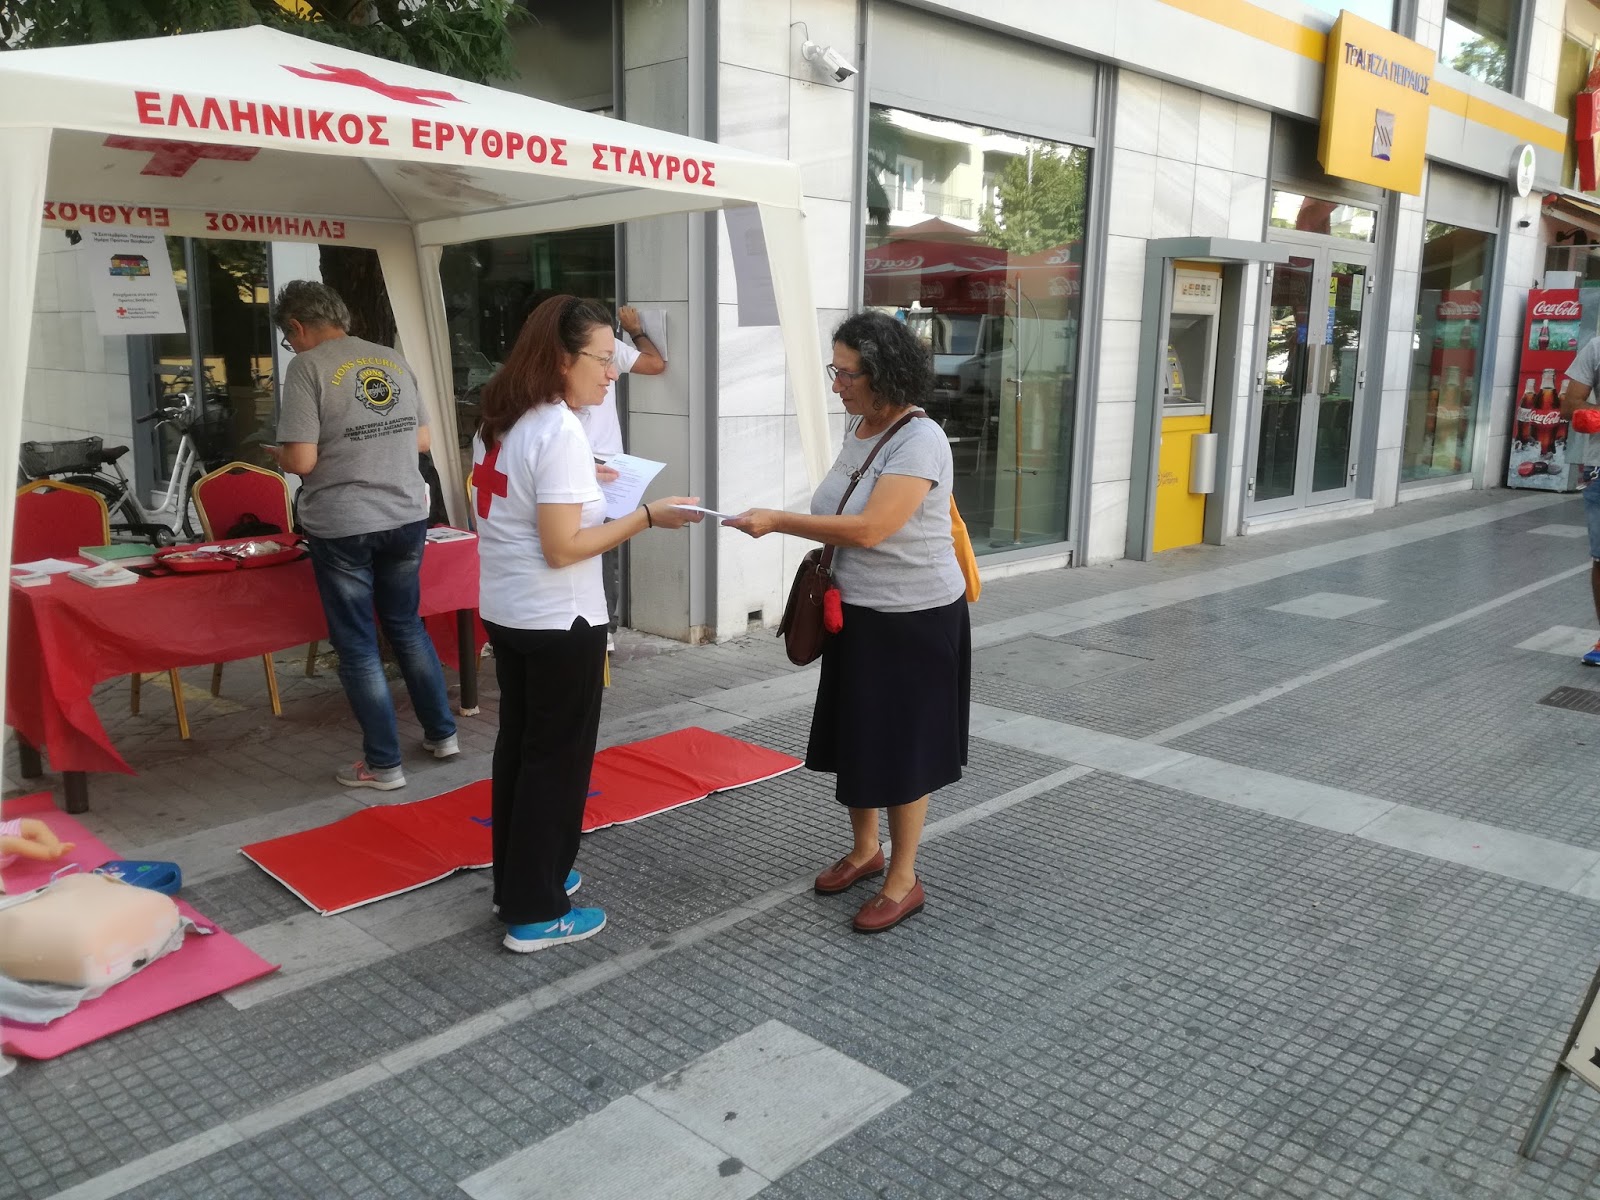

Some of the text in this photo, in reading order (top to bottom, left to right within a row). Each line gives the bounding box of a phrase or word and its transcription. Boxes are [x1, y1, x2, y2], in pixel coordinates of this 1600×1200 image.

[1345, 42, 1430, 95] ΤΡΑΠΕΖΑ ΠΕΙΡΑΙΩΣ
[135, 91, 716, 187] ΕΛΛΗΝΙΚΟΣ ΕΡΥΘΡΟΣ ΣΤΑΥΡΟΣ
[1533, 300, 1580, 316] Coca-Cola
[331, 360, 355, 386] LIONS
[360, 368, 383, 380] LIONS
[1530, 410, 1561, 425] Coca-Cola
